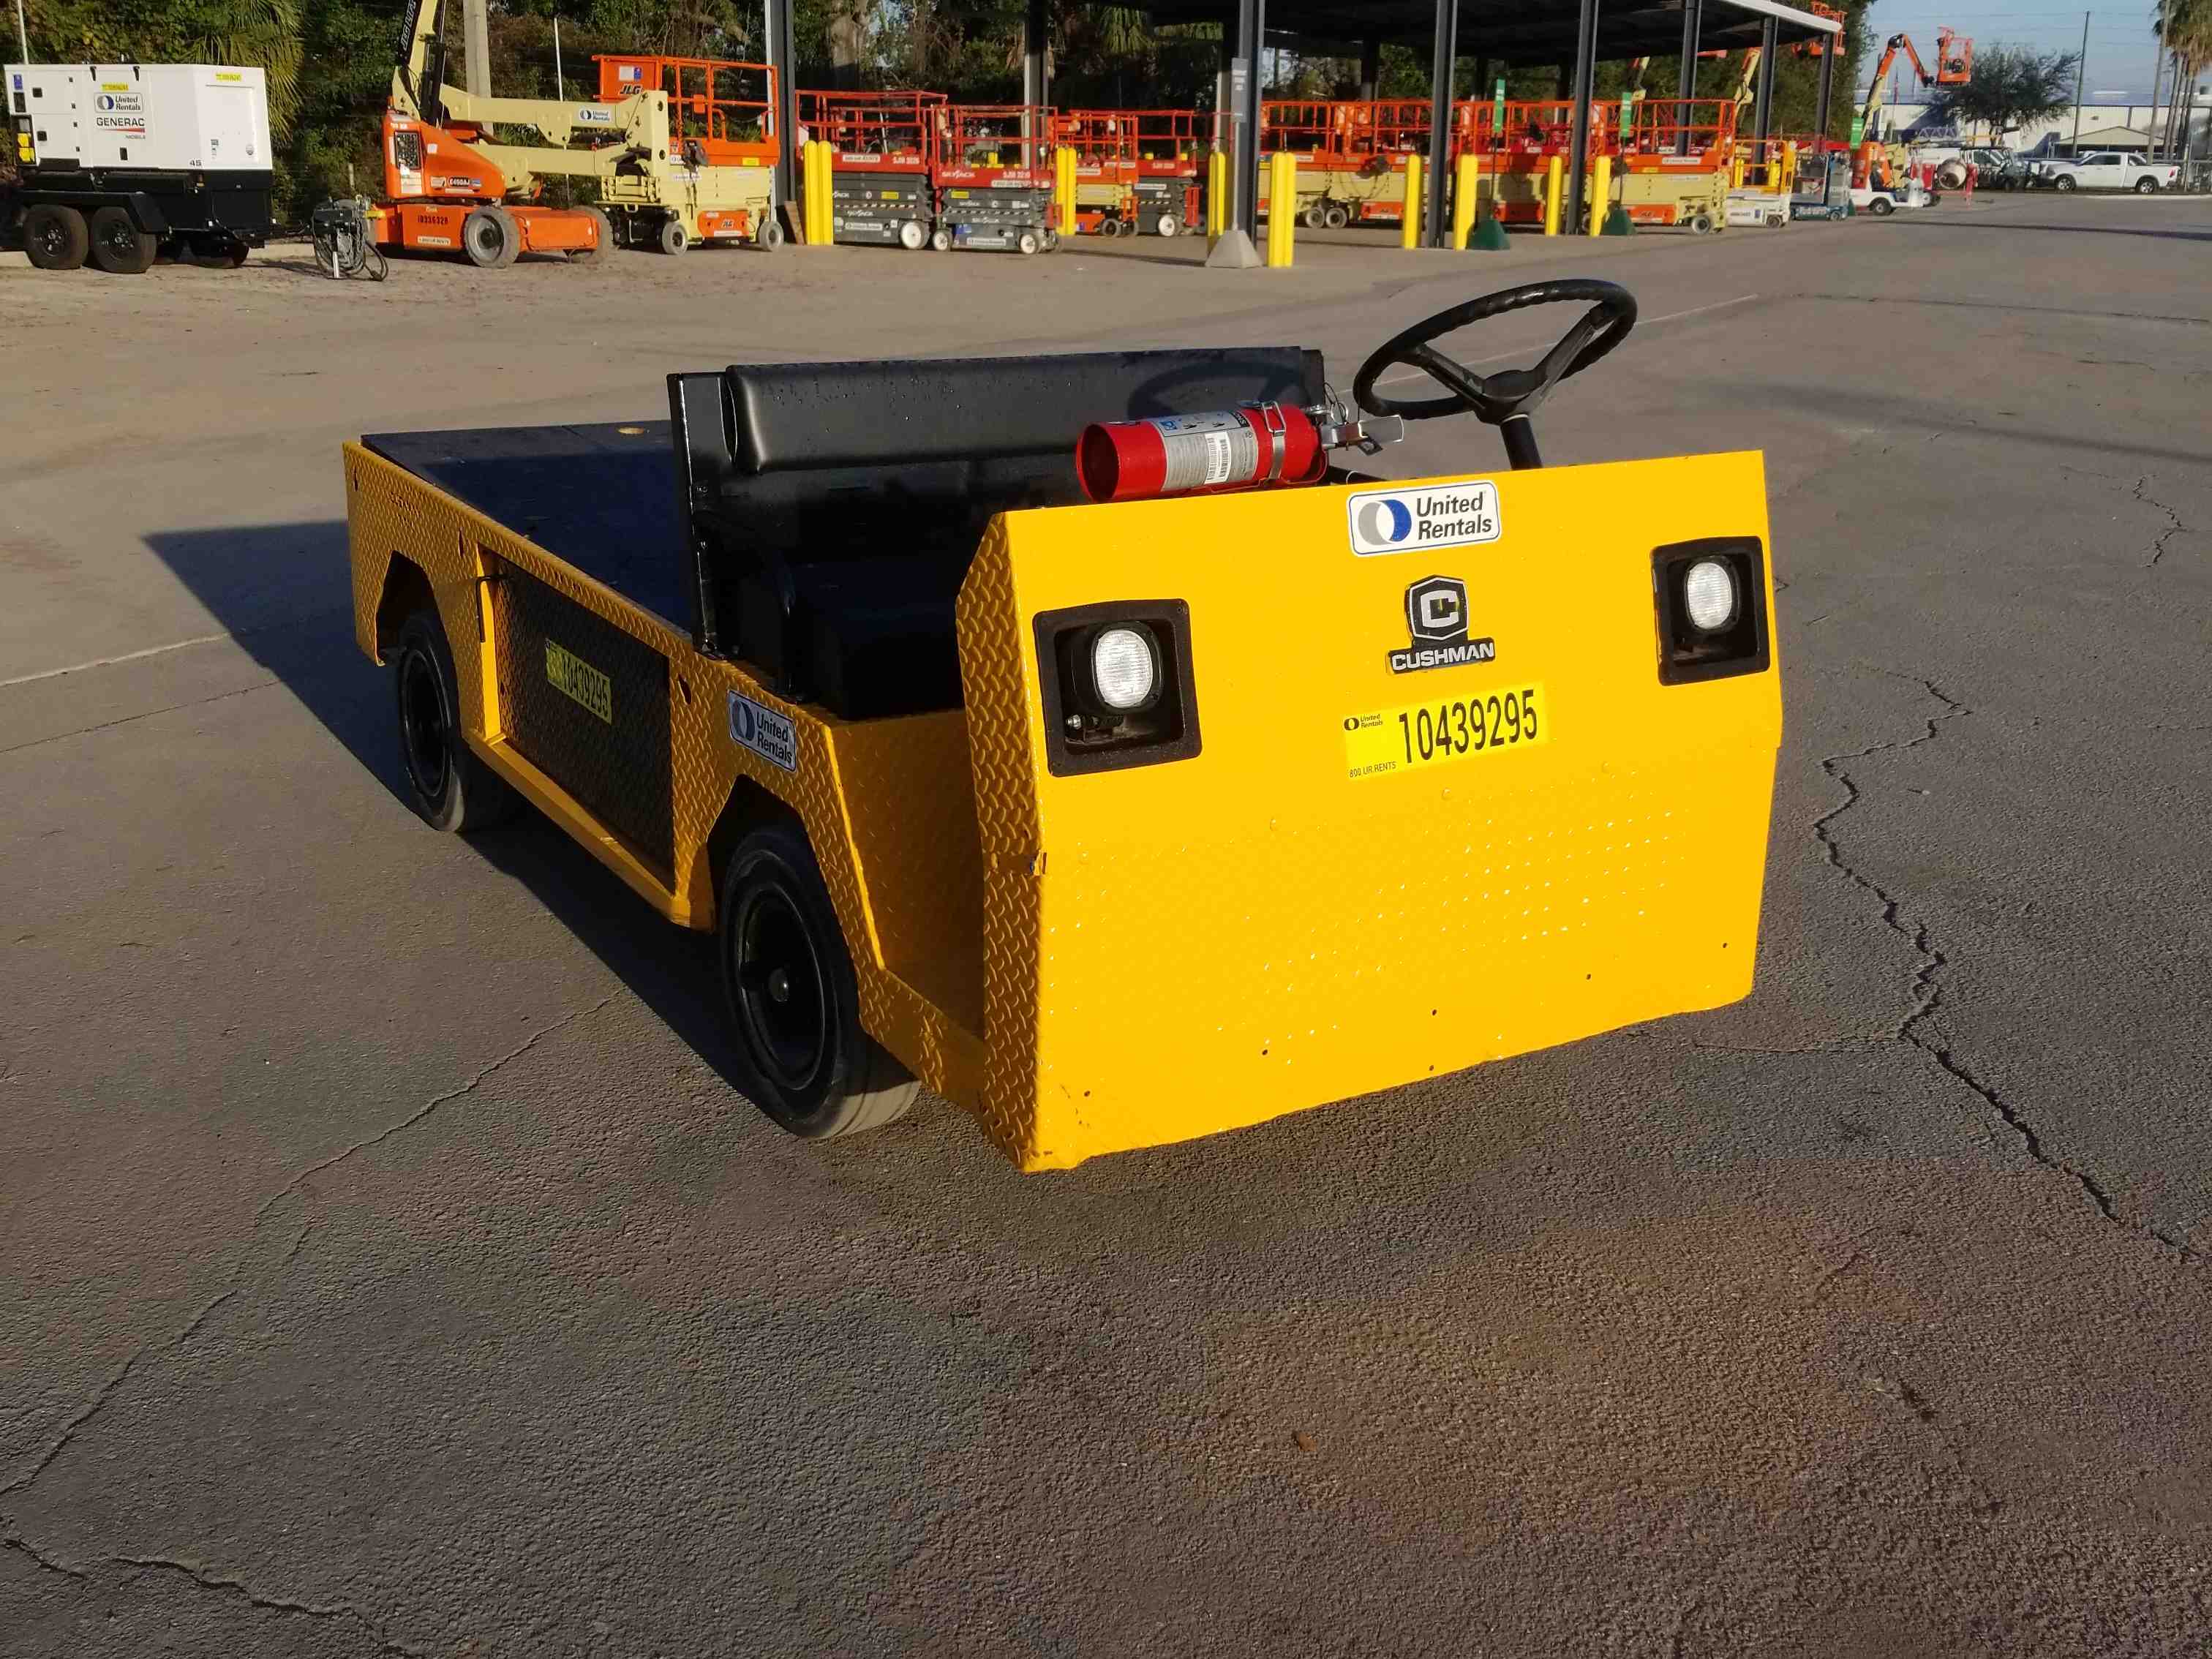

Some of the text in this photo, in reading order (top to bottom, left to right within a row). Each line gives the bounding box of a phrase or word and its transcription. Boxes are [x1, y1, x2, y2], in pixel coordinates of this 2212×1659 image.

[620, 83, 642, 94] JLG
[96, 117, 145, 127] GENERAC
[1416, 491, 1483, 517] United
[1418, 514, 1492, 540] Rentals
[1391, 642, 1494, 672] CUSHMAN
[562, 652, 609, 718] 10439295
[756, 712, 789, 742] United
[1361, 713, 1381, 723] United
[1361, 720, 1383, 729] Rentals
[1399, 689, 1538, 764] 10439295
[758, 731, 793, 764] Rentals
